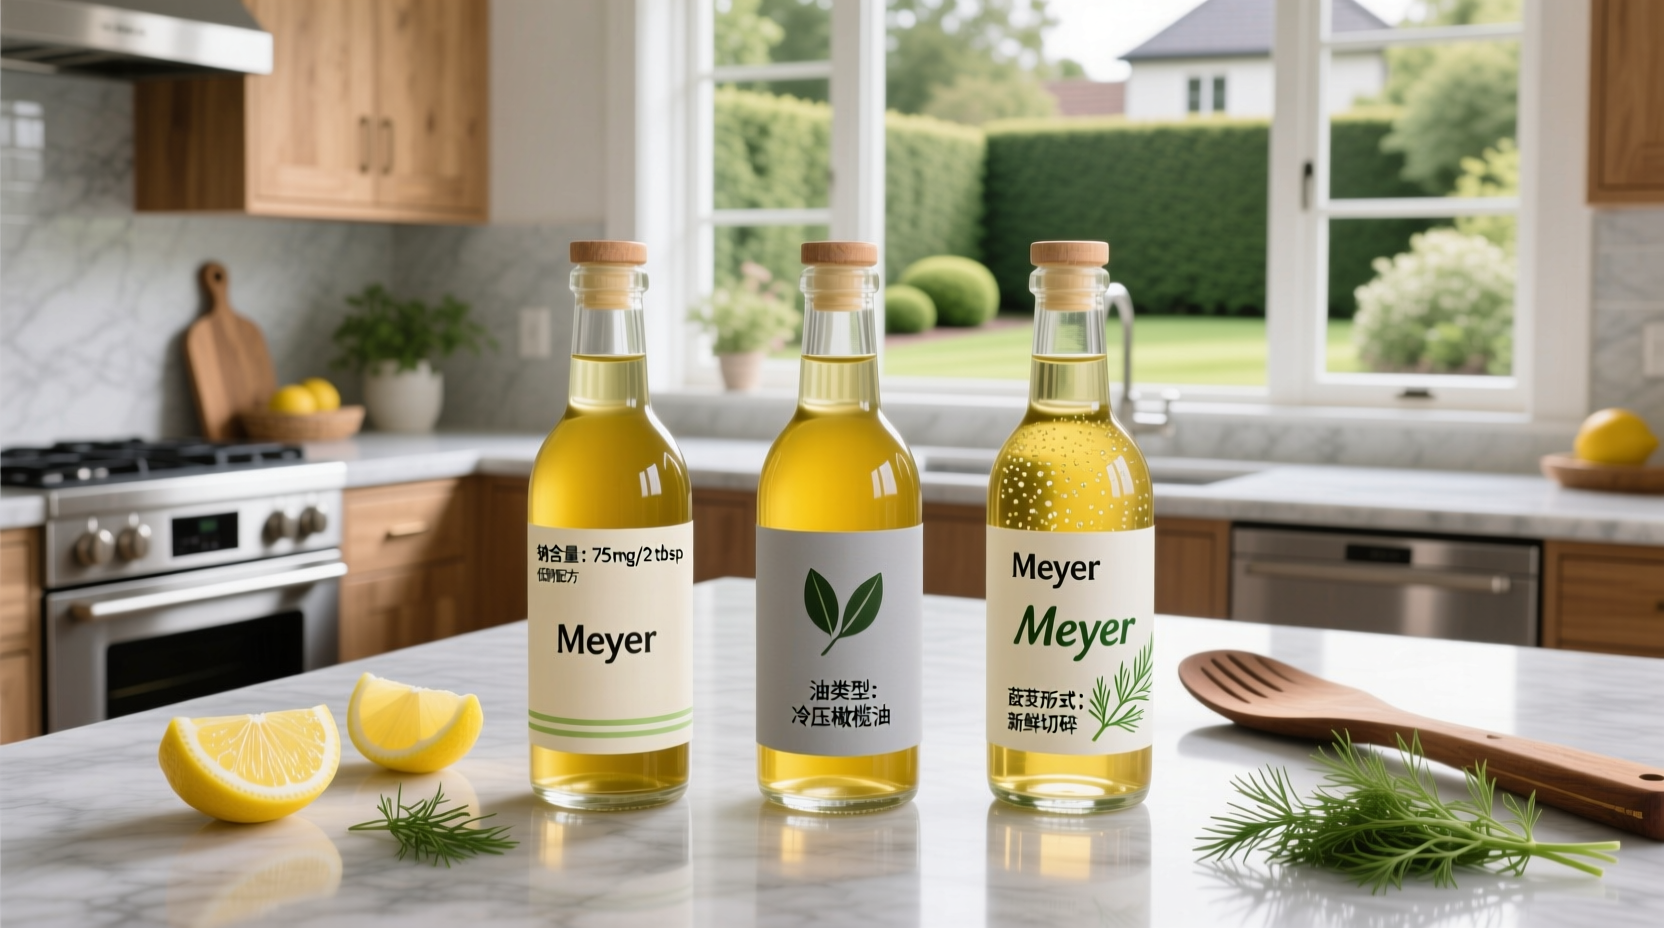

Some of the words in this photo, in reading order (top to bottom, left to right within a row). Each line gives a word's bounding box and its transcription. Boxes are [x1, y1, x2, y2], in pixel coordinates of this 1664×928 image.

[592, 546, 652, 567] 75mg/2
[654, 544, 684, 564] tbsp
[1012, 552, 1101, 589] Meyer
[557, 624, 657, 664] Meyer
[1013, 604, 1136, 662] Meyer
[791, 703, 891, 728] 冷压橄榄油
